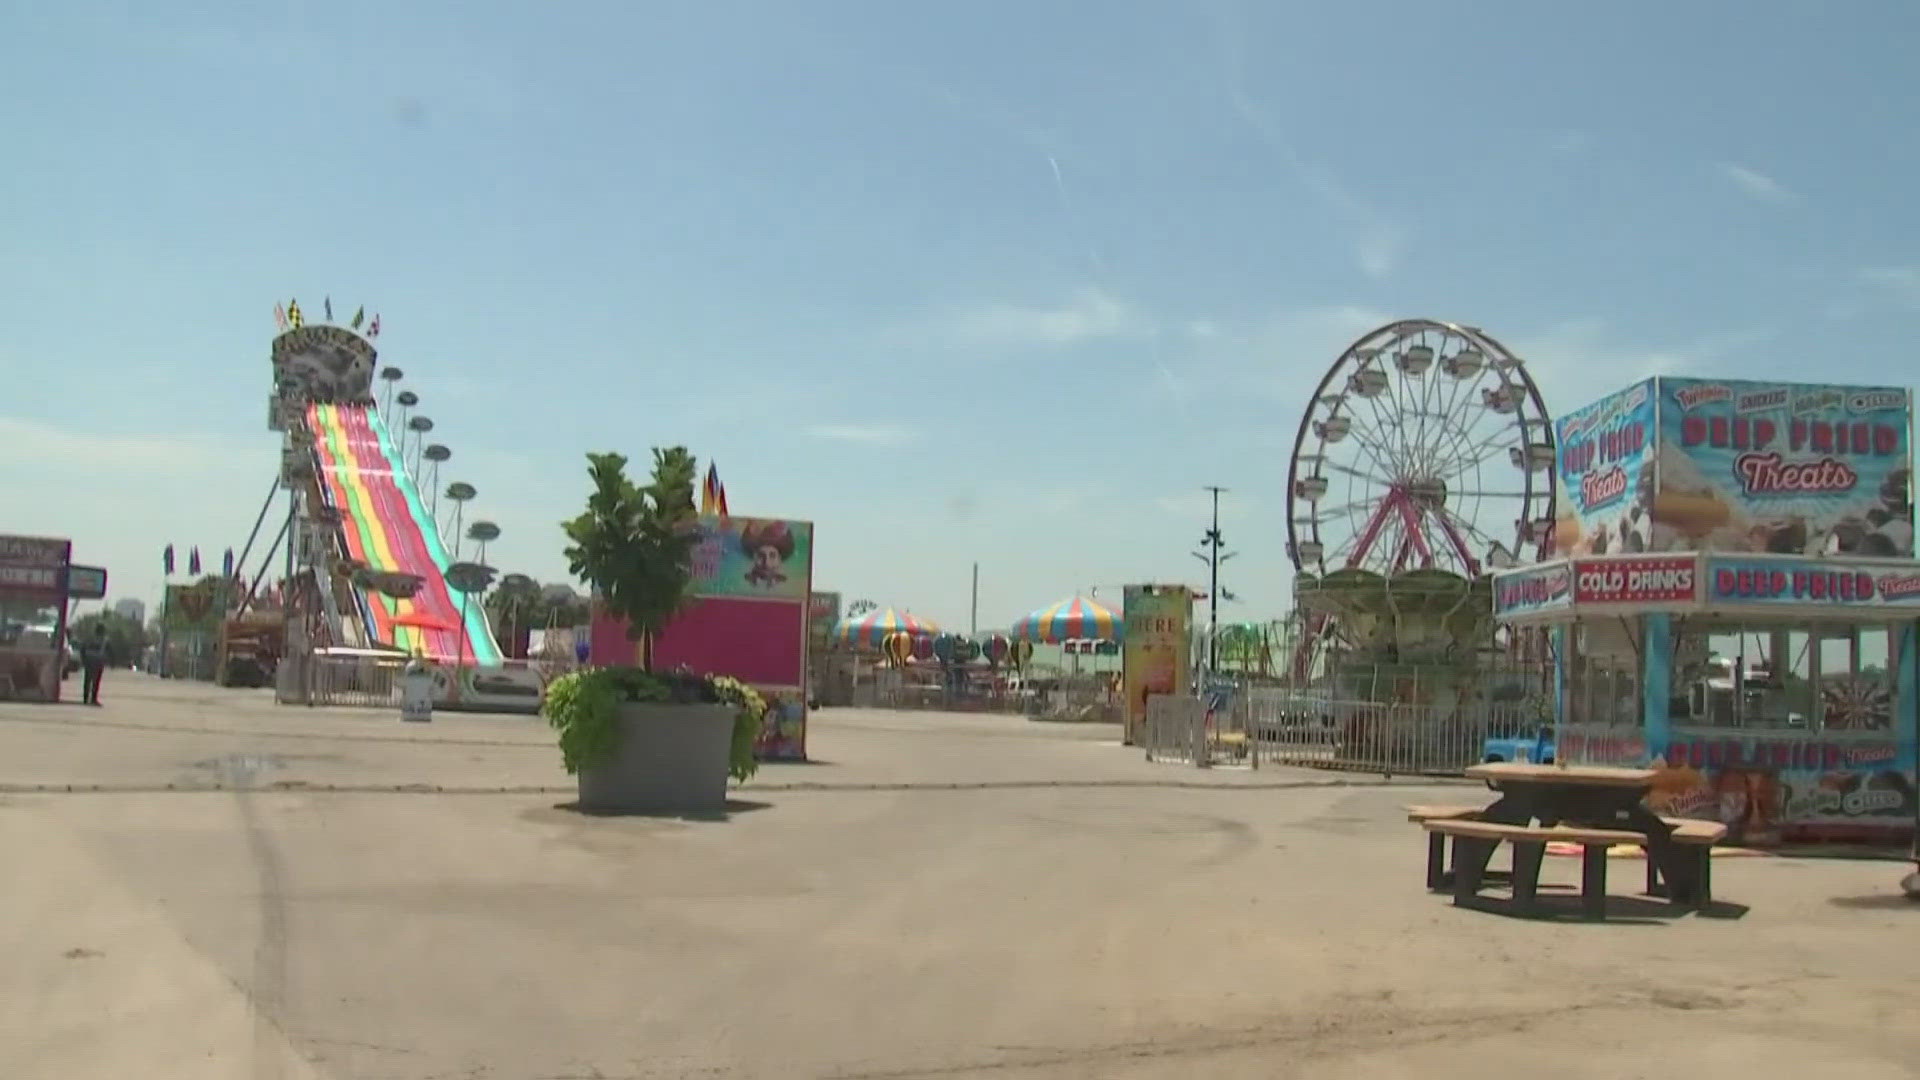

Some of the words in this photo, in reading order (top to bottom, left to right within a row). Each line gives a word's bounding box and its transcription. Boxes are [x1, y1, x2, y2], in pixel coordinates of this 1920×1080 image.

[1682, 416, 1776, 450] DEEP
[1790, 417, 1898, 455] FRIED
[1583, 466, 1626, 508] Treats
[1738, 454, 1854, 494] Treats
[1579, 571, 1624, 592] COLD
[1628, 568, 1693, 592] DRINKS
[1717, 568, 1787, 598] DEEP
[1793, 571, 1875, 601] FRIED
